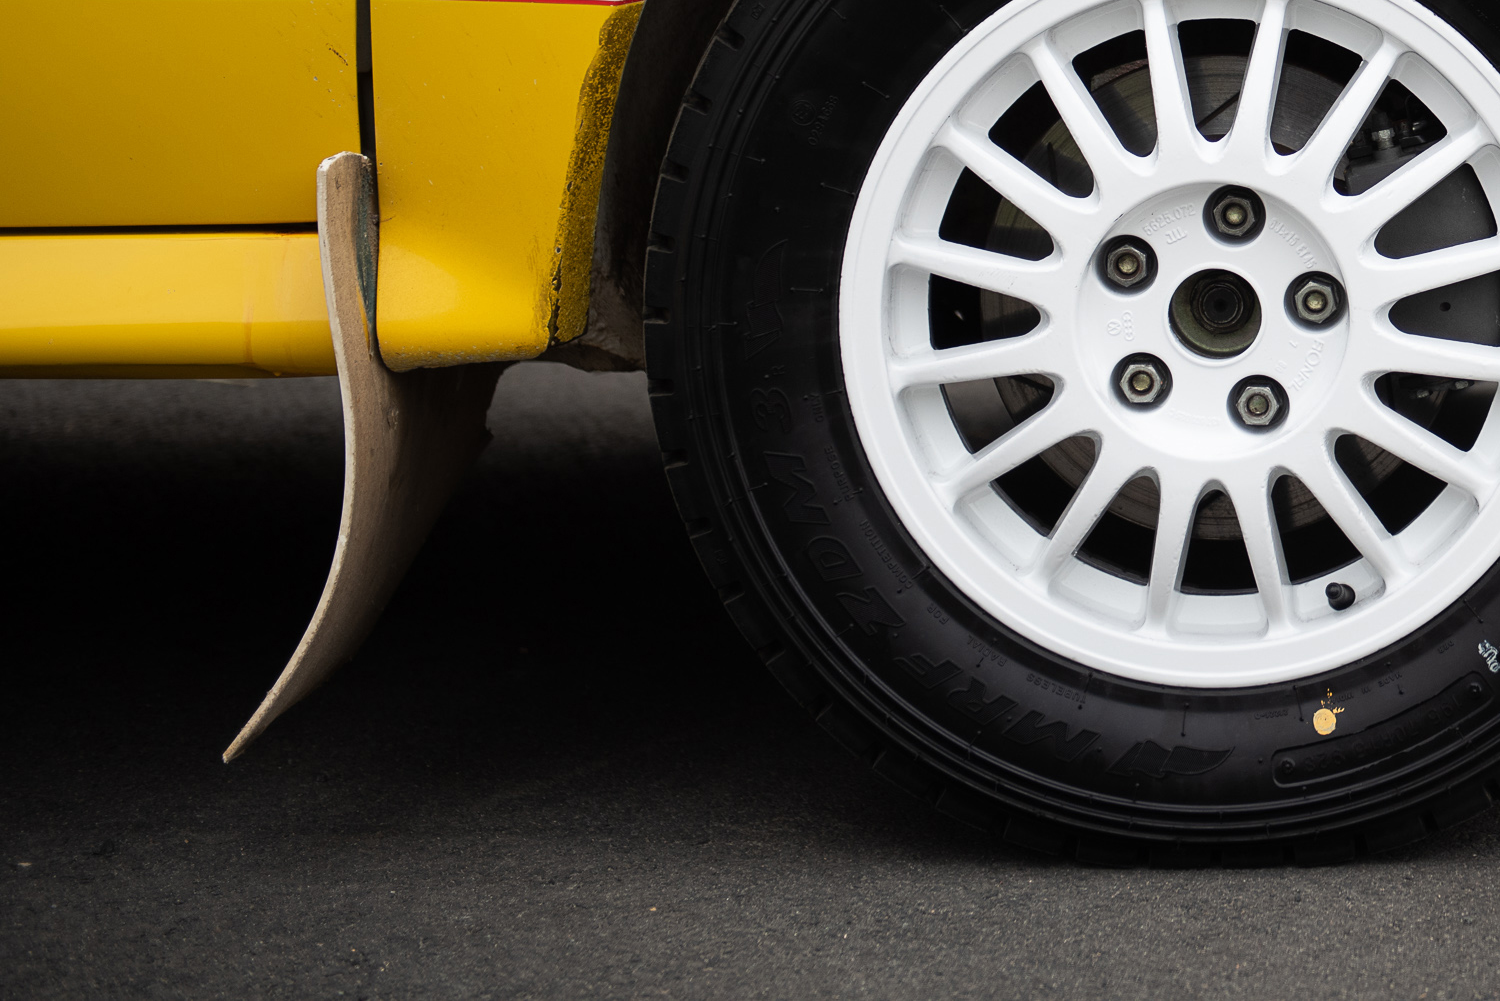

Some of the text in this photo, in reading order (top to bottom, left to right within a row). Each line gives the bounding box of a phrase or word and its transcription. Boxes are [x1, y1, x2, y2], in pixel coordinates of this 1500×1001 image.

[748, 386, 792, 436] 3
[762, 449, 907, 637] ZDM
[858, 519, 914, 590] COMPETITION
[893, 652, 1099, 763] MRF
